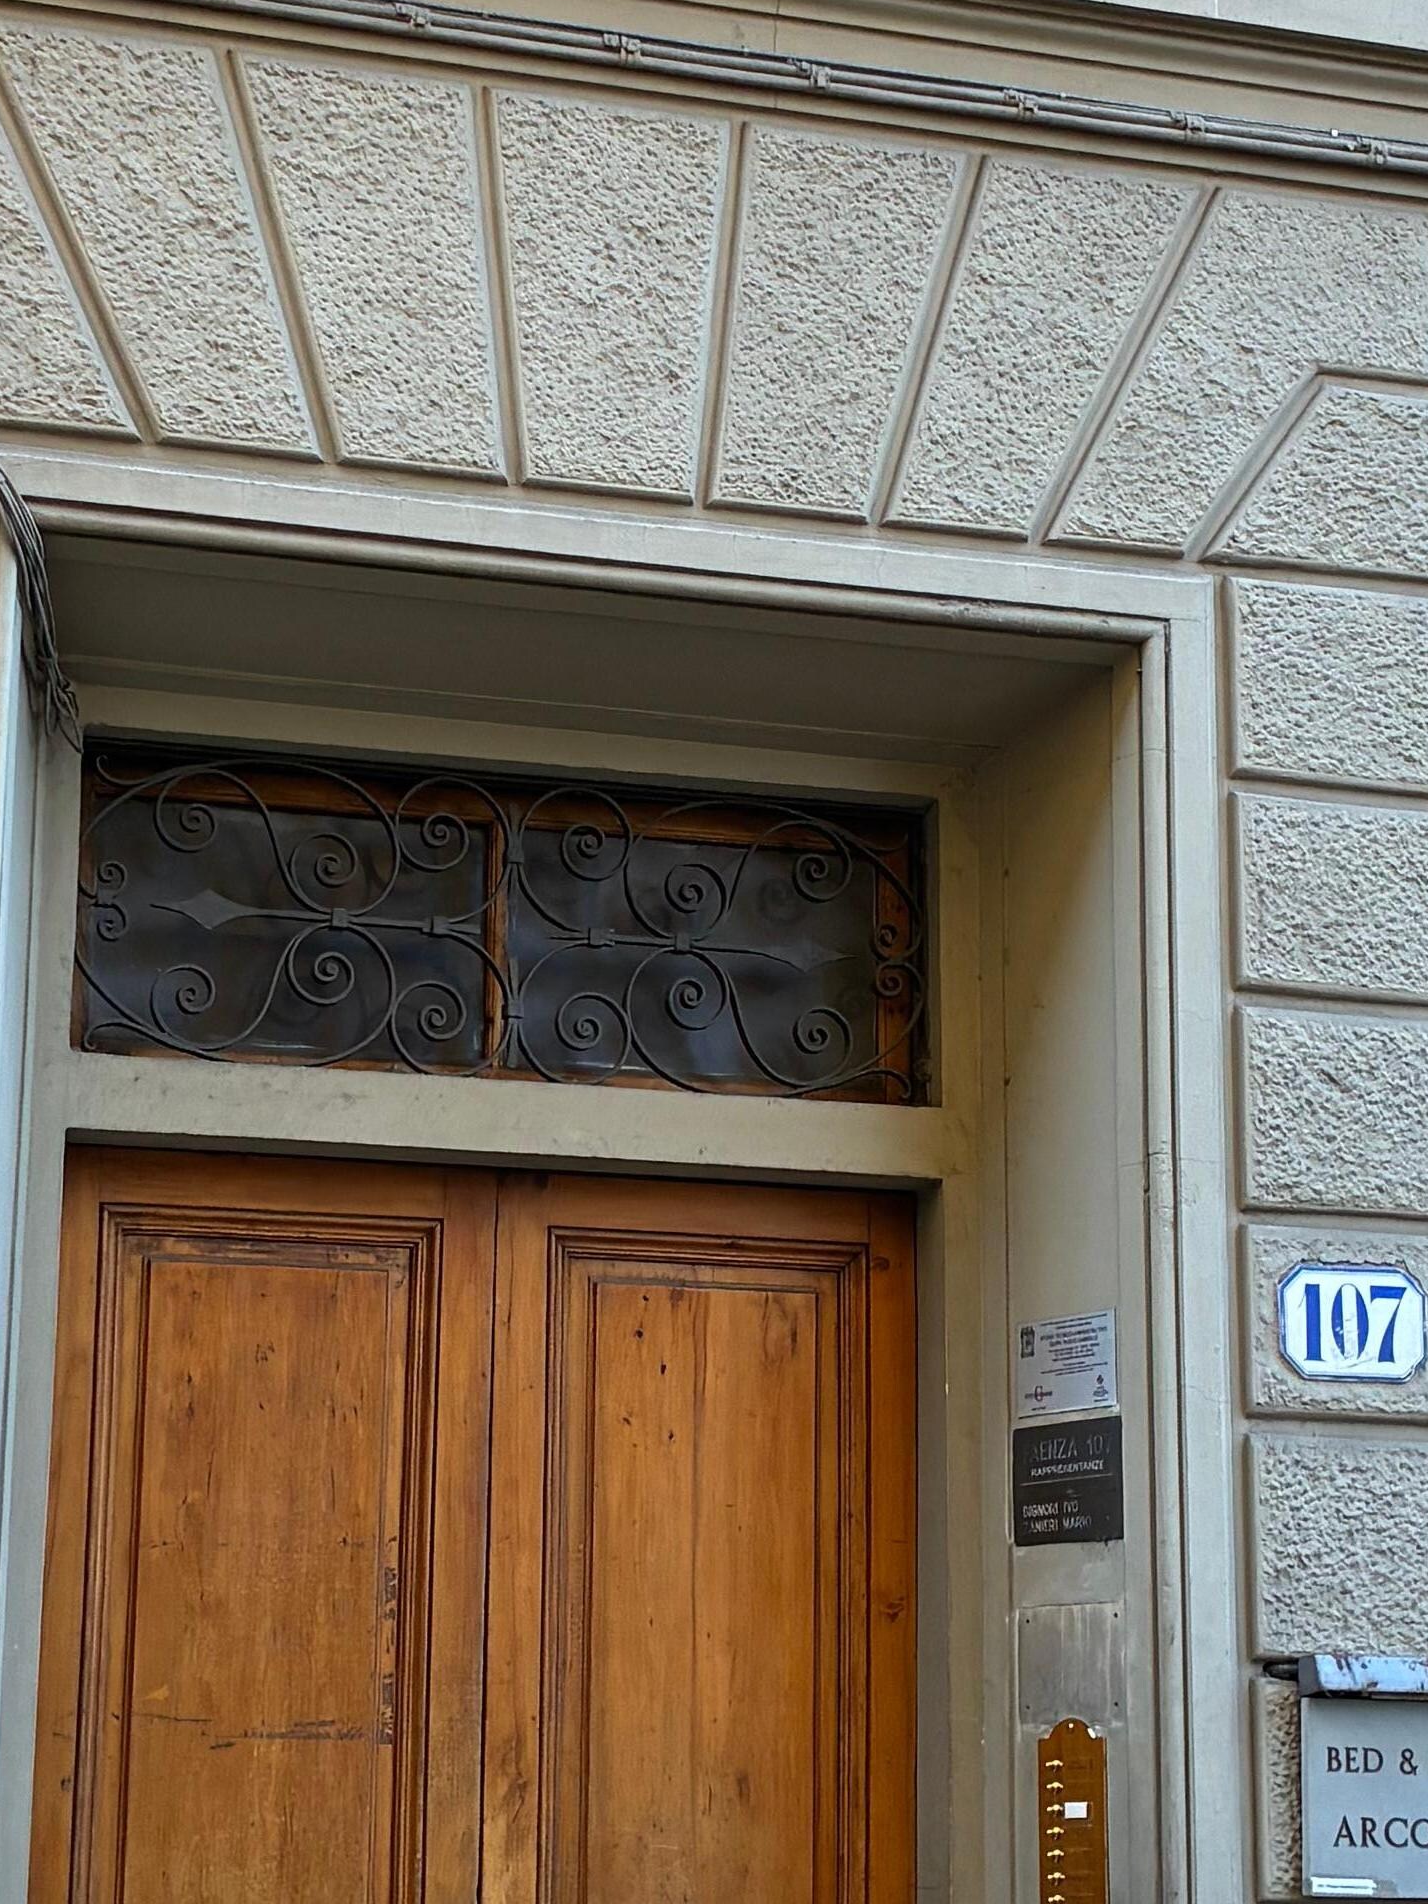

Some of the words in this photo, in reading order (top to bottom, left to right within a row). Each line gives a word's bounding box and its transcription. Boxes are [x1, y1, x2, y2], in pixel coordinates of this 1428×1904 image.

[1299, 1282, 1408, 1364] 107
[1326, 1746, 1384, 1774] BED
[1399, 1748, 1418, 1776] &
